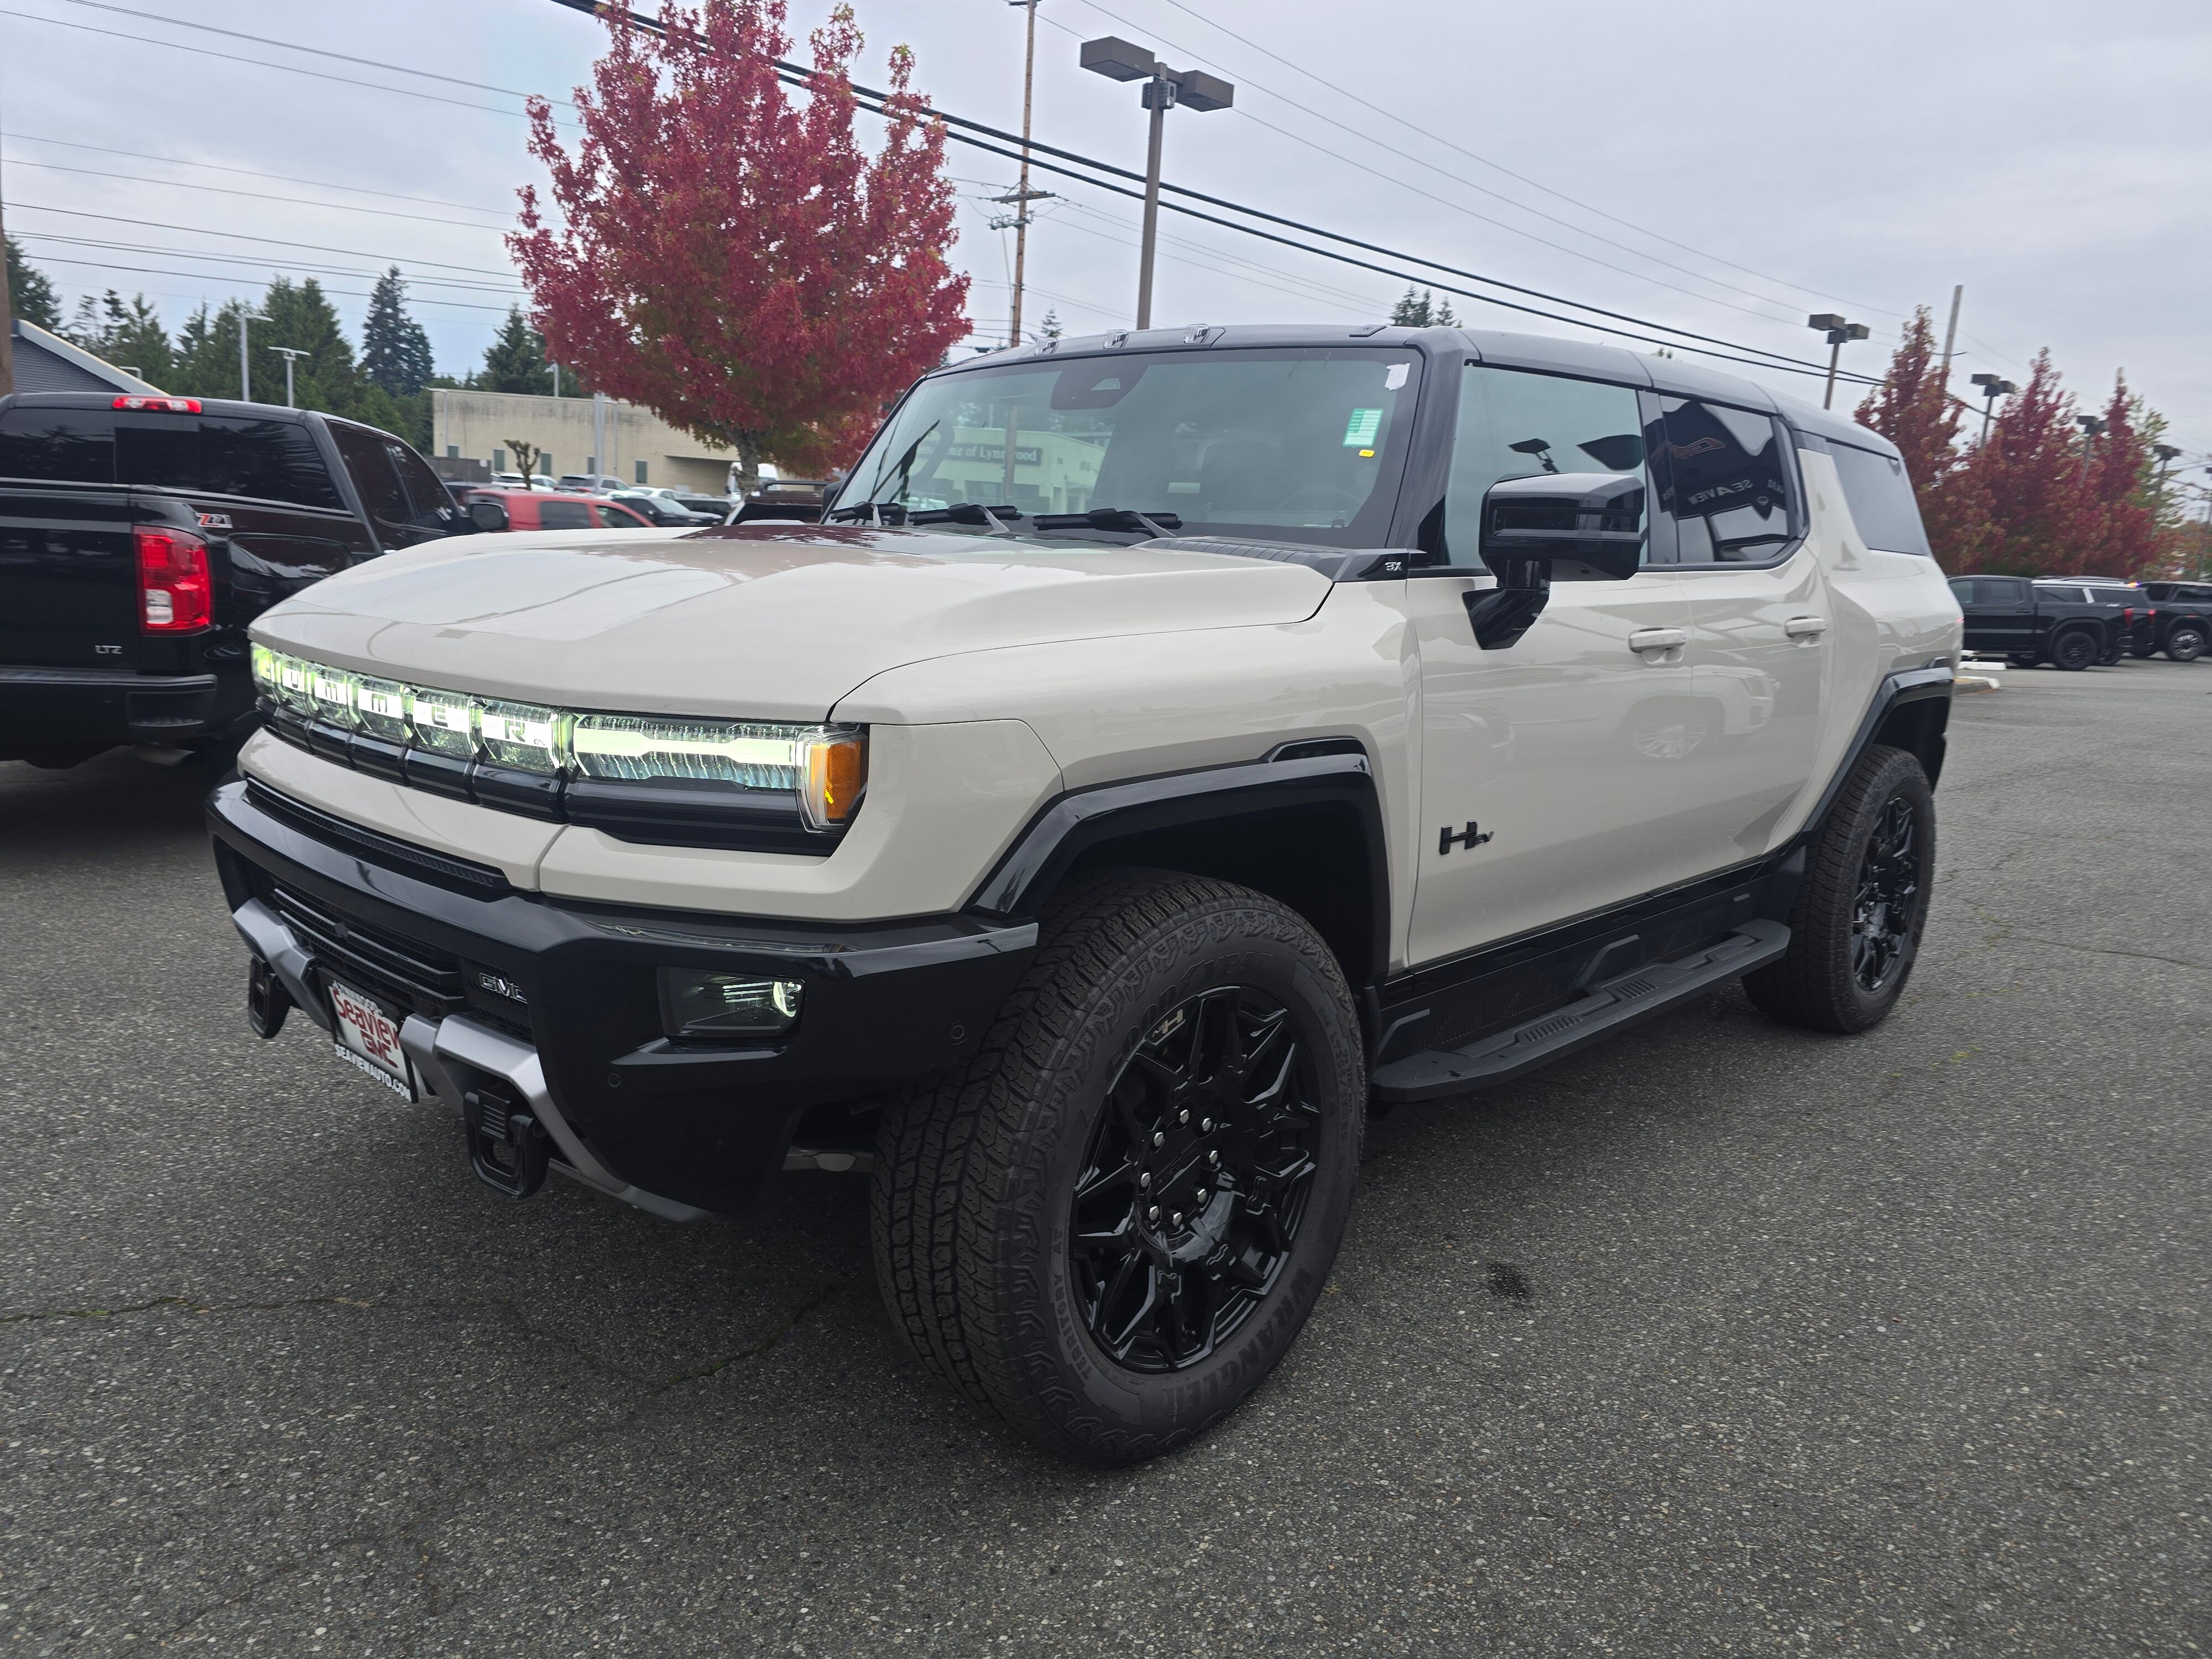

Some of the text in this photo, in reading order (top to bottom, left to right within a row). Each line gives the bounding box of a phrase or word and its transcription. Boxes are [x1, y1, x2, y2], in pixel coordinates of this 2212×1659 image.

[979, 446, 1037, 461] Lynnood
[195, 512, 233, 528] Z71
[1385, 561, 1403, 571] 3X
[95, 645, 123, 654] LTZ
[479, 972, 529, 1004] GMC
[332, 989, 399, 1051] Seaview
[359, 1035, 399, 1068] GMC
[1050, 1228, 1093, 1381] TERRITORY AT
[1162, 1267, 1314, 1417] WRANGLER
